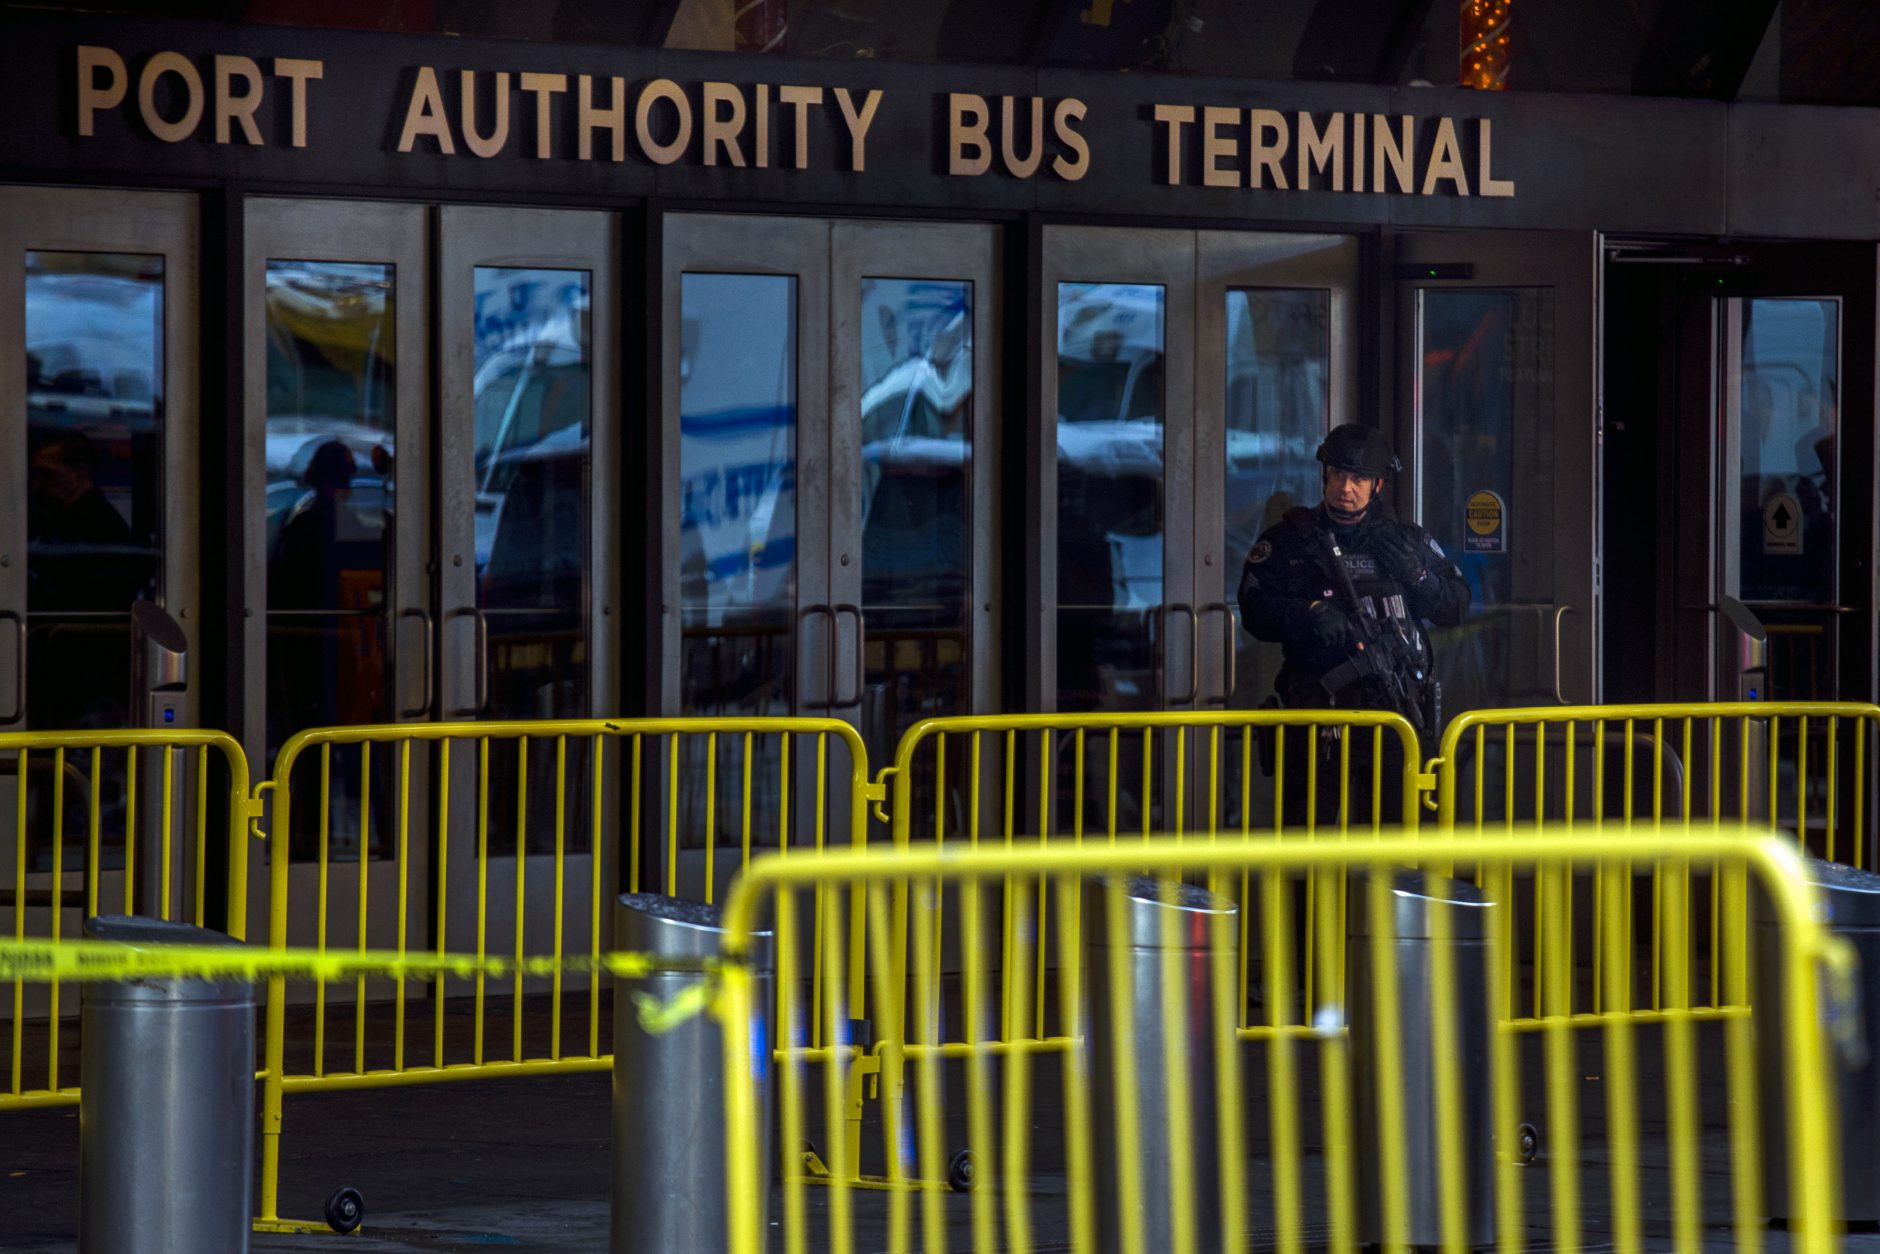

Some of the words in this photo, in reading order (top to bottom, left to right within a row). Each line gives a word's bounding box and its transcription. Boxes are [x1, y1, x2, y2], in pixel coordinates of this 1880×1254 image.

[77, 45, 325, 148] PORT
[398, 66, 884, 172] AUTHORITY
[949, 93, 1090, 181] BUS
[1153, 104, 1516, 198] TERMINAL
[1468, 509, 1499, 518] CAUTION
